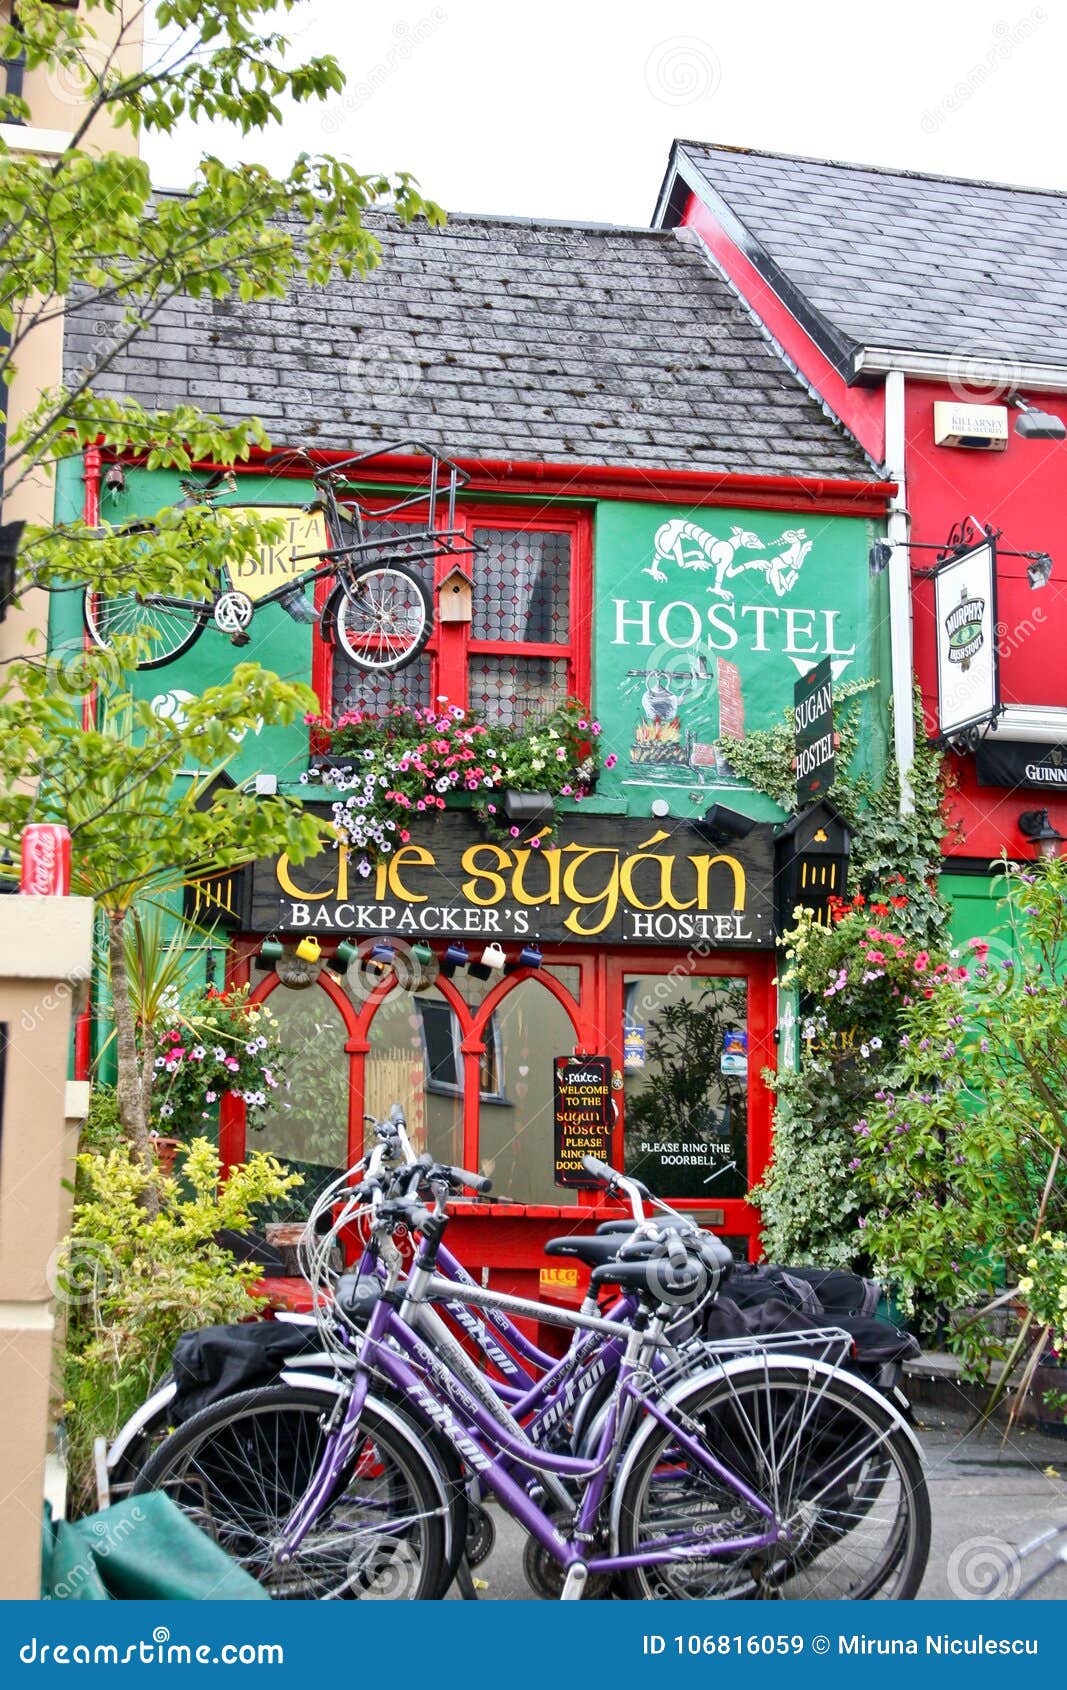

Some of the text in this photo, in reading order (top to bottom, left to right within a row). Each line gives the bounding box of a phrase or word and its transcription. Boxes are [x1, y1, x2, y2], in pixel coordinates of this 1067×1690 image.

[610, 599, 857, 656] HOSTEL
[795, 682, 832, 735] SUGAN
[796, 733, 835, 780] HOSTEL
[290, 903, 753, 940] BACKPACKER'S HOSTEL
[559, 1085, 609, 1095] WELCOME
[566, 1097, 602, 1106] TO THE
[566, 1138, 603, 1147] PLEASE
[641, 1142, 731, 1153] PLEASE RING THE
[561, 1150, 608, 1159] RING THE
[661, 1155, 717, 1166] DOORBELL
[405, 1384, 494, 1471] FALCON
